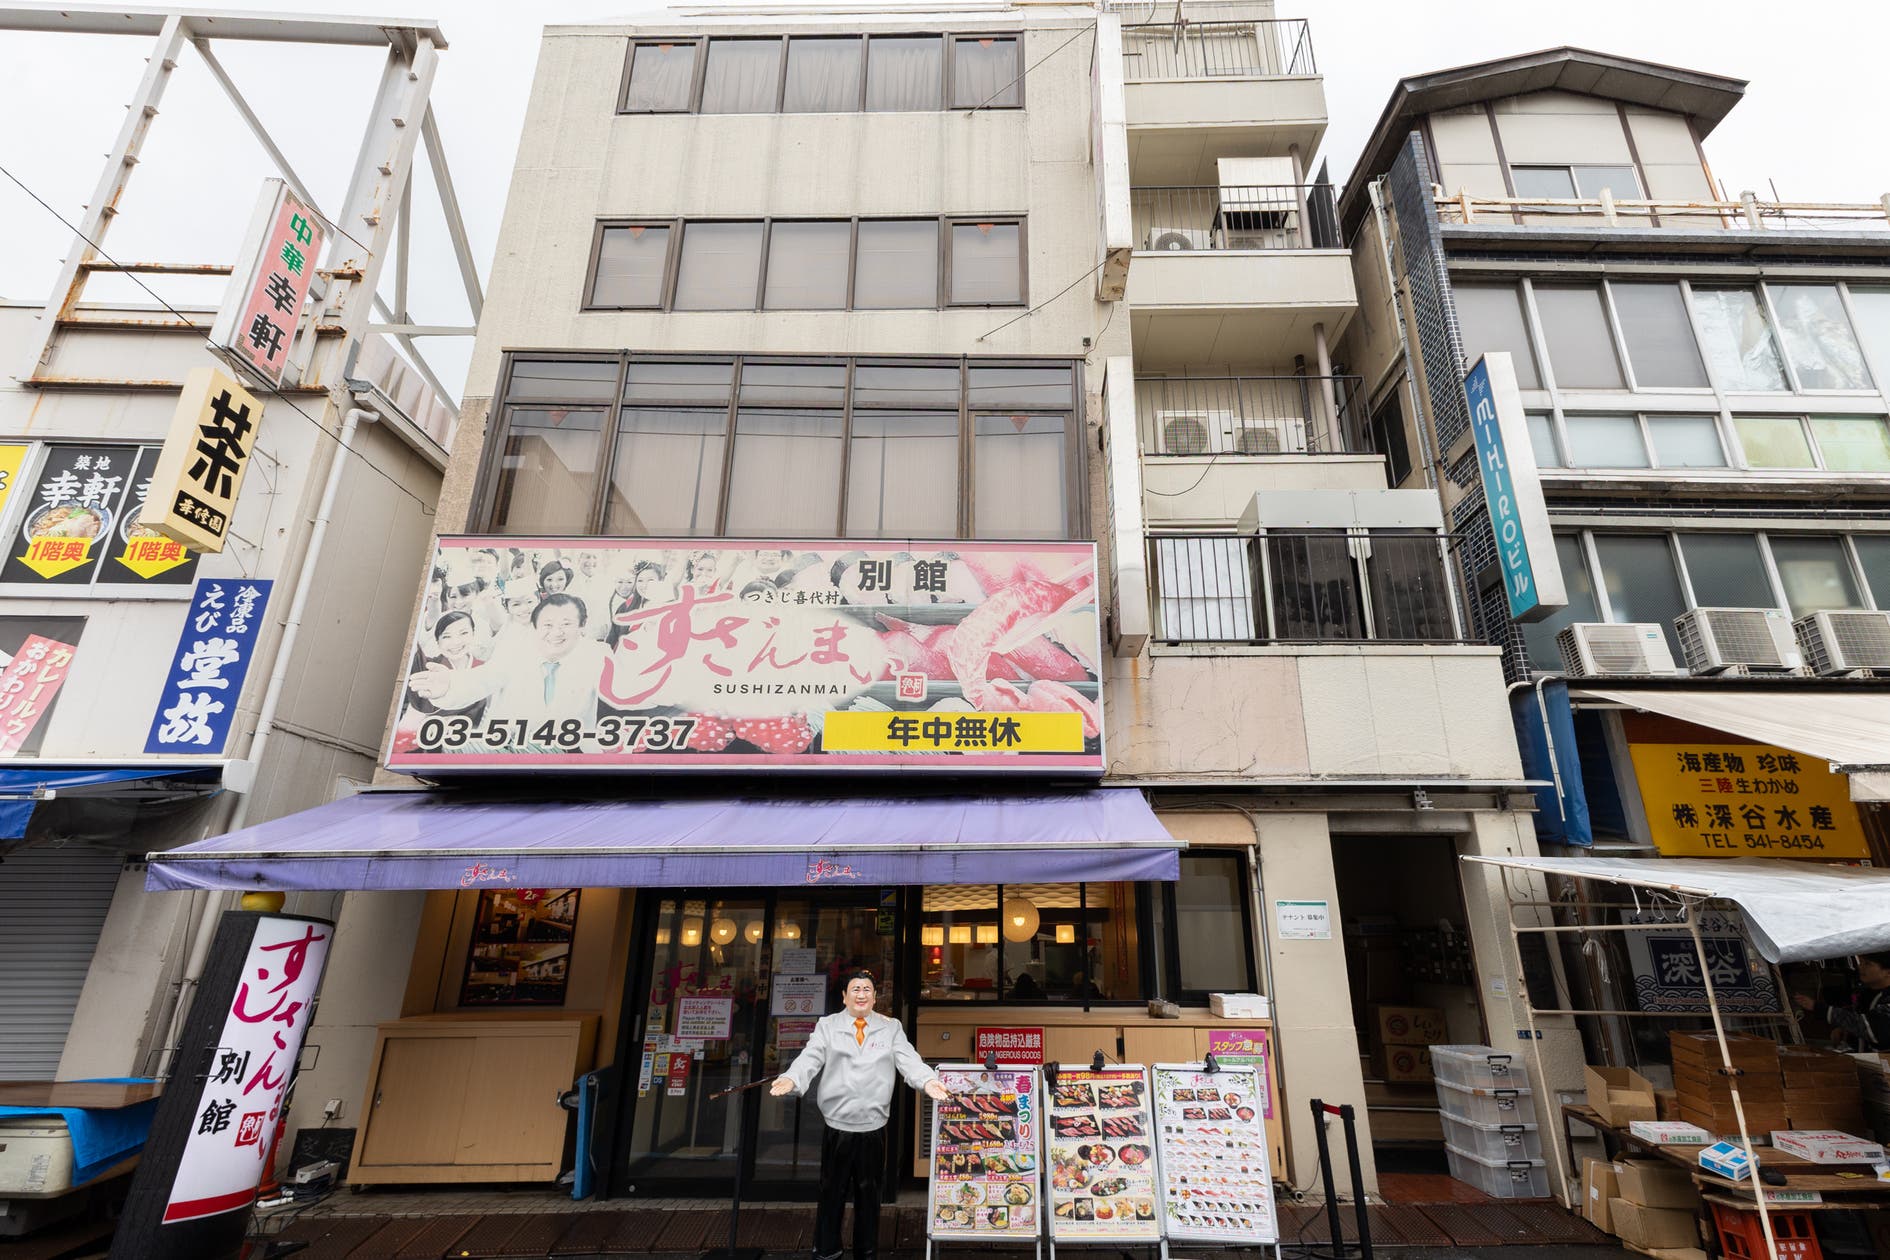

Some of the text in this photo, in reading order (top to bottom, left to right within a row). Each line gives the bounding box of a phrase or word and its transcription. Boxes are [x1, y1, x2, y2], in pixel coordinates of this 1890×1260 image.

[187, 388, 252, 500] 茶
[73, 454, 112, 471] 築地
[40, 469, 123, 510] 幸軒
[31, 540, 86, 562] 1階奥
[128, 540, 182, 562] 1階奥
[195, 583, 226, 633] えび
[747, 589, 841, 606] つきじ喜代村
[712, 683, 848, 695] SUSHIZANMAI
[417, 718, 697, 749] 03-5148-3737
[886, 715, 1022, 747] 年中無休
[1676, 752, 1802, 774] 海産物 珍味
[1700, 833, 1825, 850] TEL 541-8454
[978, 1032, 1042, 1049] 危険物品持込厳禁
[978, 1050, 1042, 1060] NO NGEROUS GOODS
[197, 1050, 252, 1136] 別館
[1014, 1074, 1033, 1140] 春まつり
